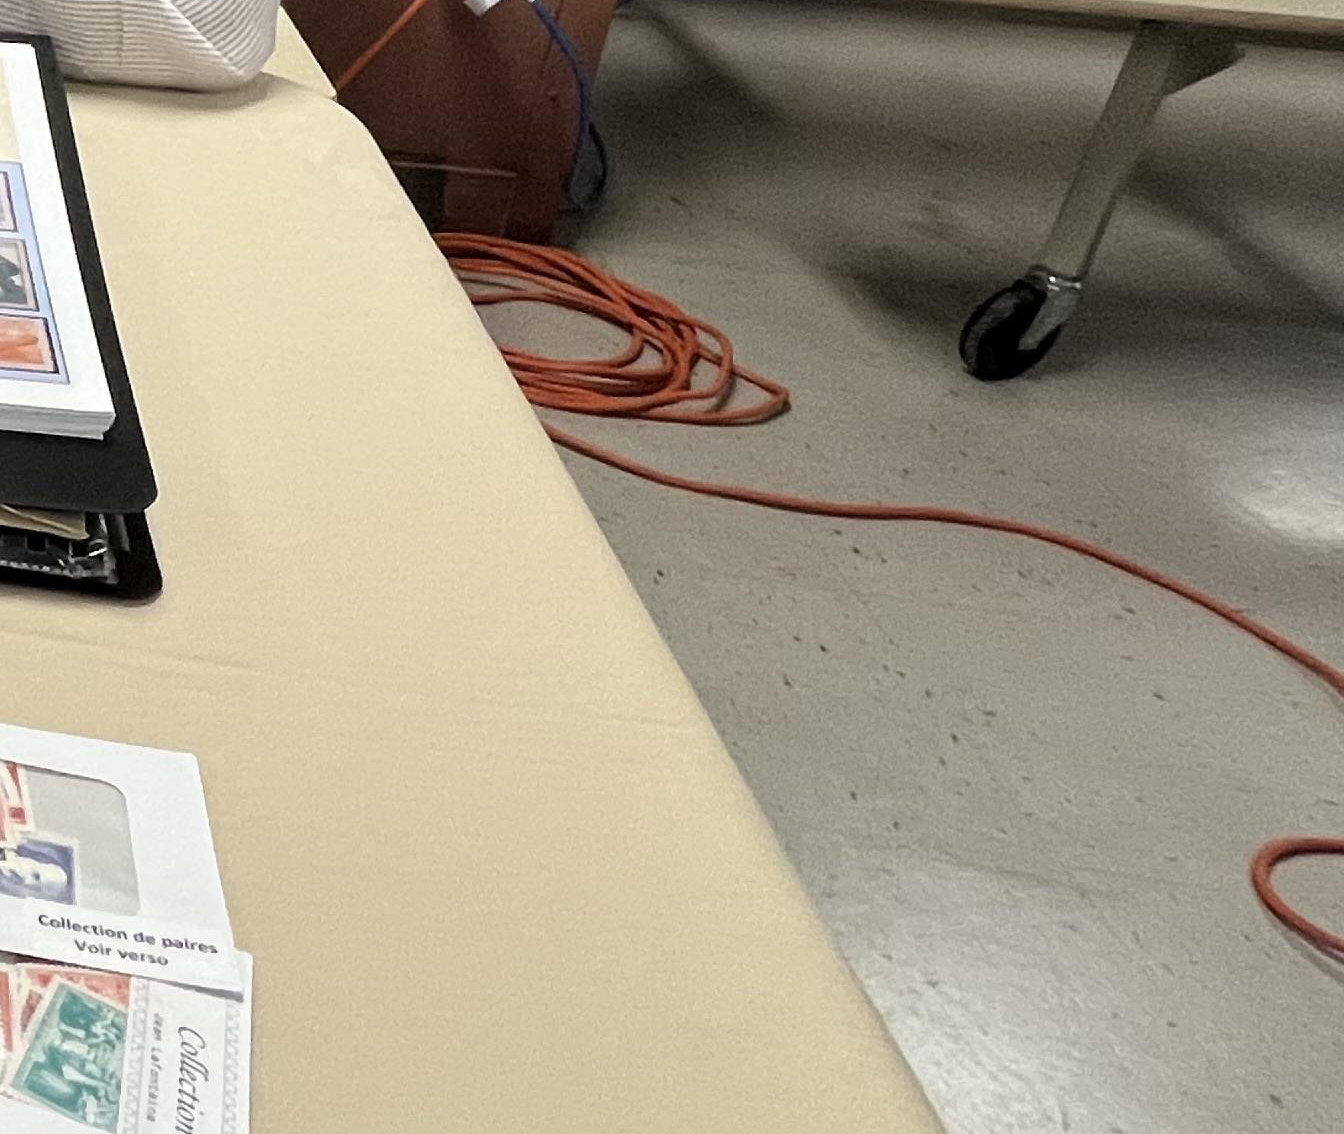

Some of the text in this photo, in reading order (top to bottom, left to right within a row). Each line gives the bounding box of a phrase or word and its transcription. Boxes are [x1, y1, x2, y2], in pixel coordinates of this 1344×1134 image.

[38, 913, 219, 954] Collection de paires
[73, 938, 169, 966] Voir verso
